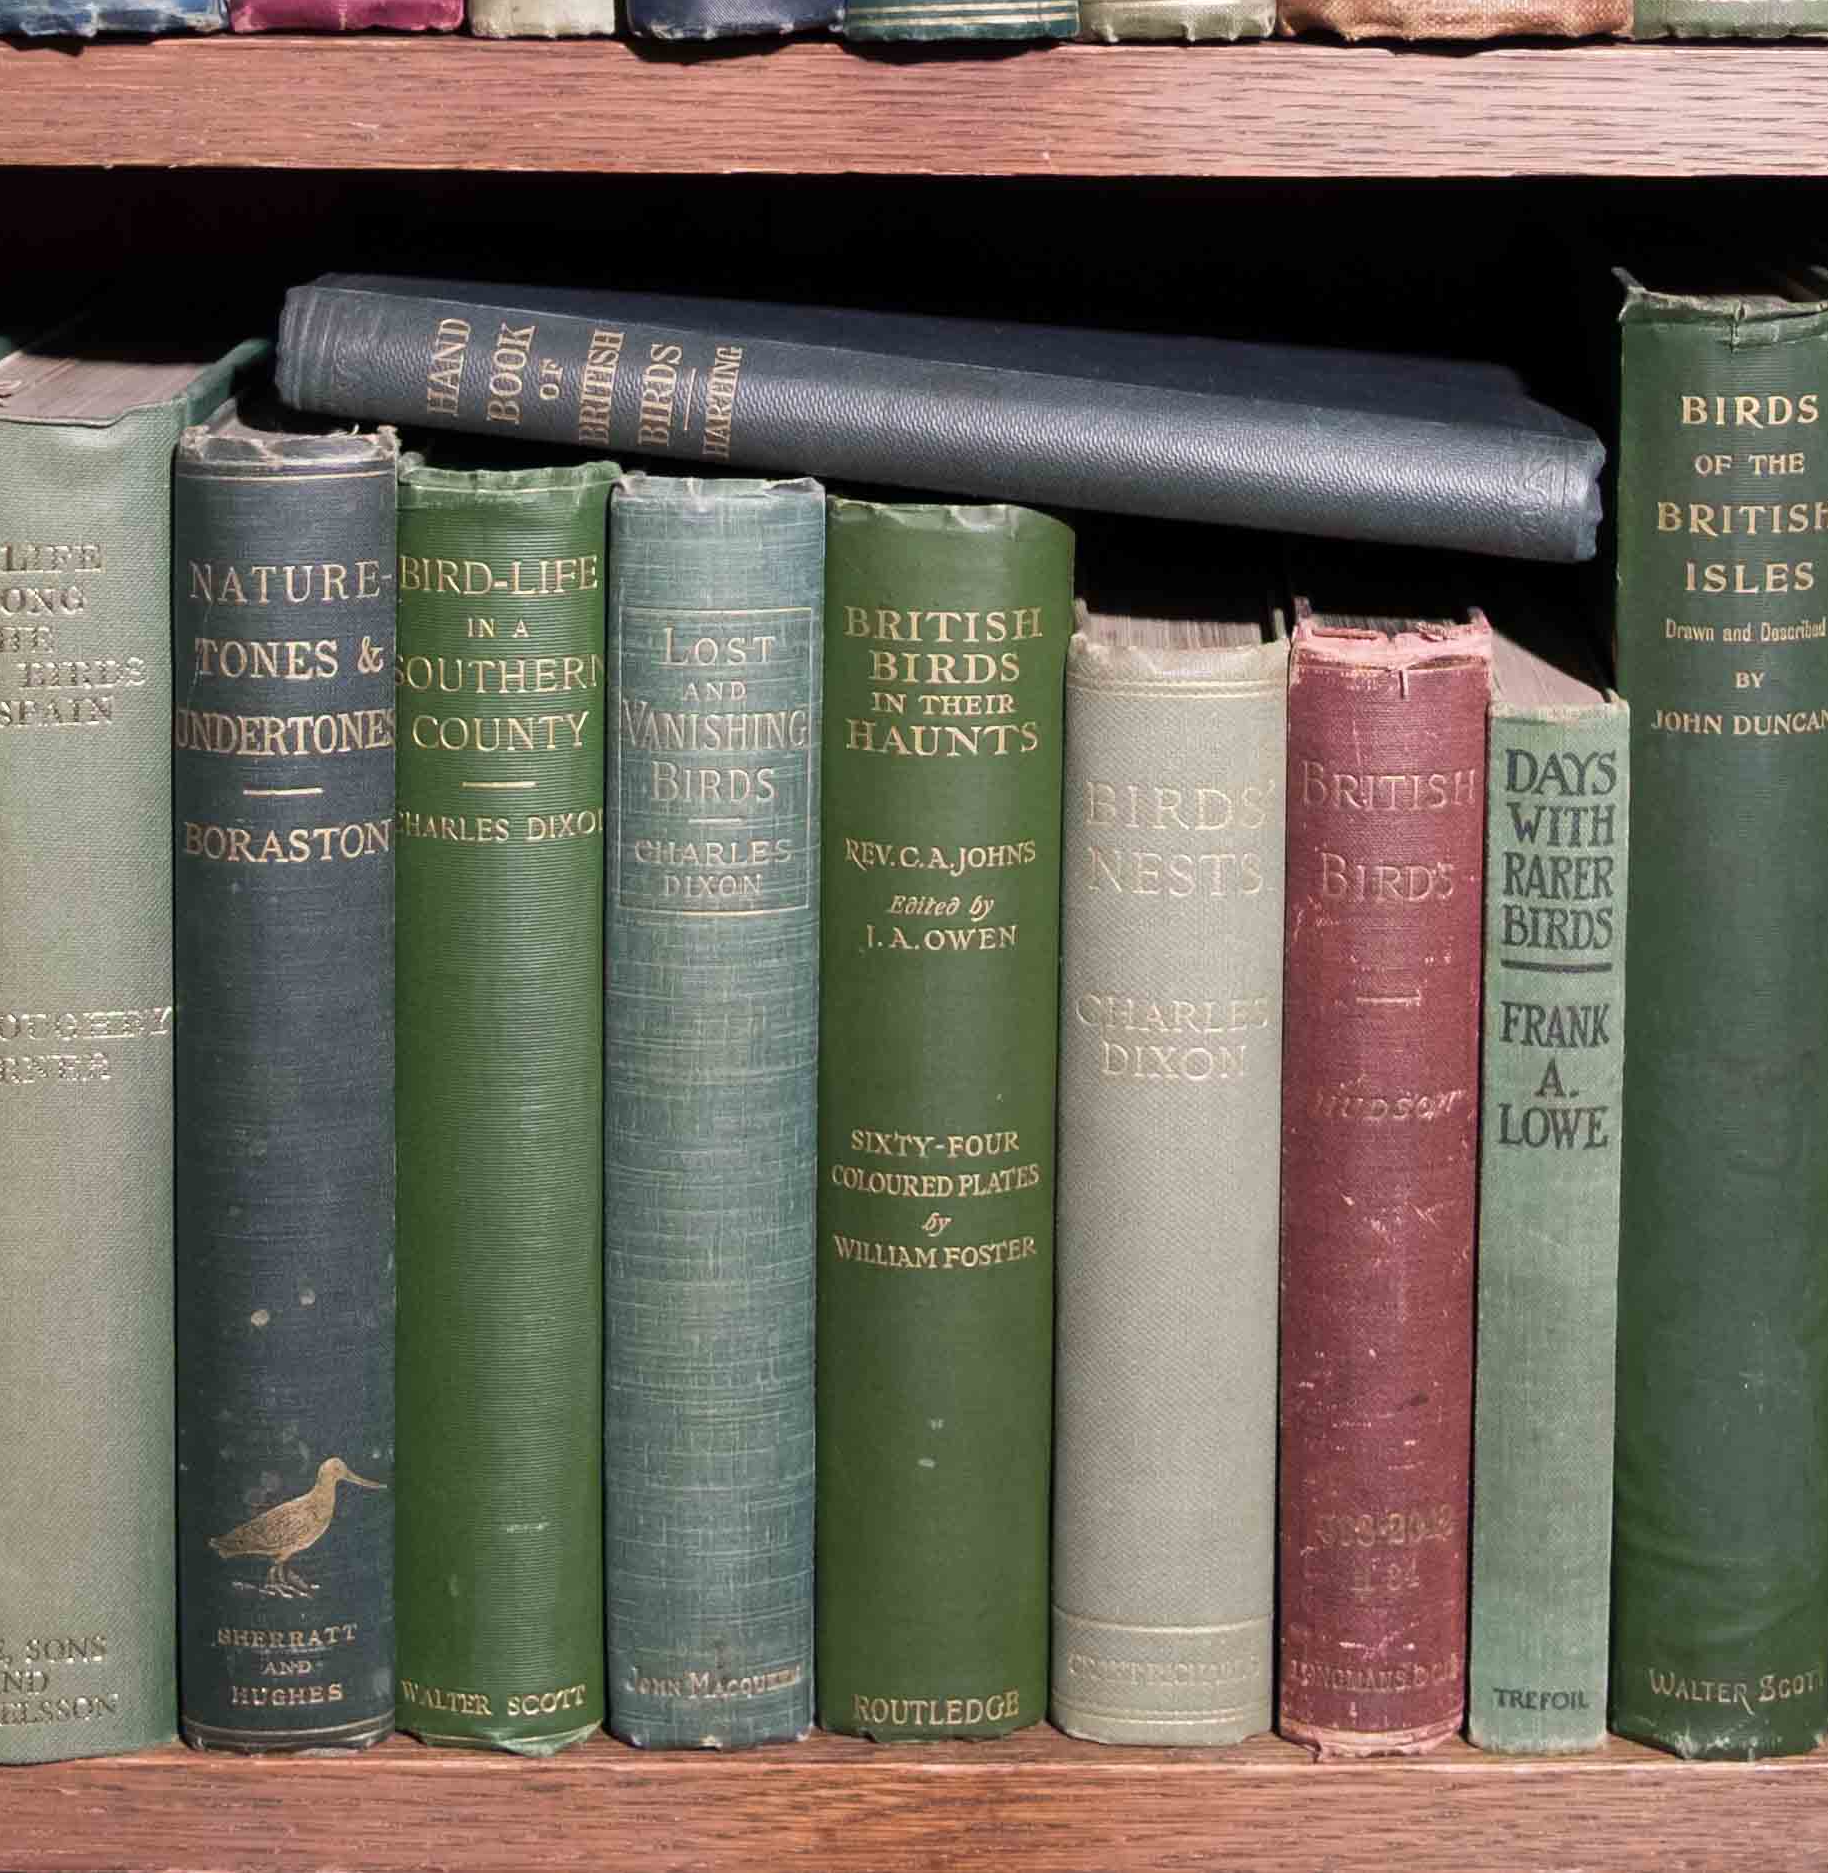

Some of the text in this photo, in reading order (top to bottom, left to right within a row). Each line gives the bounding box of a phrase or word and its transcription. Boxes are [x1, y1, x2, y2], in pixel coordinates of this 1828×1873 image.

[427, 318, 471, 416] HAND
[486, 322, 537, 425] BOOK
[579, 328, 626, 445] BRITISH
[638, 343, 683, 447] BIRDS
[1681, 395, 1819, 428] BIRDS
[1694, 452, 1806, 477] OF THE
[399, 554, 598, 597] BIRD-LIFE
[1684, 561, 1815, 595] ISLES
[467, 618, 531, 640] IN A
[843, 605, 1043, 643] BRITISH
[1665, 616, 1827, 642] Drawn and Described
[195, 636, 385, 681] TONES &
[661, 626, 776, 669] LOST
[870, 651, 1020, 686] BIRDS
[1735, 672, 1764, 690] BY
[683, 680, 747, 702] AND
[871, 692, 1017, 715] IN THEIR
[412, 712, 590, 753] COUNTY
[845, 718, 1041, 759] HAUNTS
[1651, 709, 1723, 736] JOHN
[650, 760, 776, 806] BIRDS
[1504, 748, 1617, 798] DAYS
[1505, 803, 1615, 849] WITH
[634, 838, 792, 866] CHARLES
[1504, 852, 1614, 902] RARER
[1499, 905, 1614, 950] BIRDS
[1499, 1000, 1611, 1050] FRANK
[1498, 1103, 1609, 1151] LOWE
[831, 1164, 1041, 1199] COLOURED PLATES
[833, 1235, 1036, 1270] WILLIAM FOSTER
[217, 1622, 359, 1650] SHERRATT
[230, 1684, 343, 1706] HUGHES
[399, 1679, 587, 1717] WALTER SCOTT
[851, 1690, 1020, 1727] ROUTLEDGE
[1493, 1687, 1590, 1711] TREFOIL
[1649, 1667, 1755, 1714] WALTER
